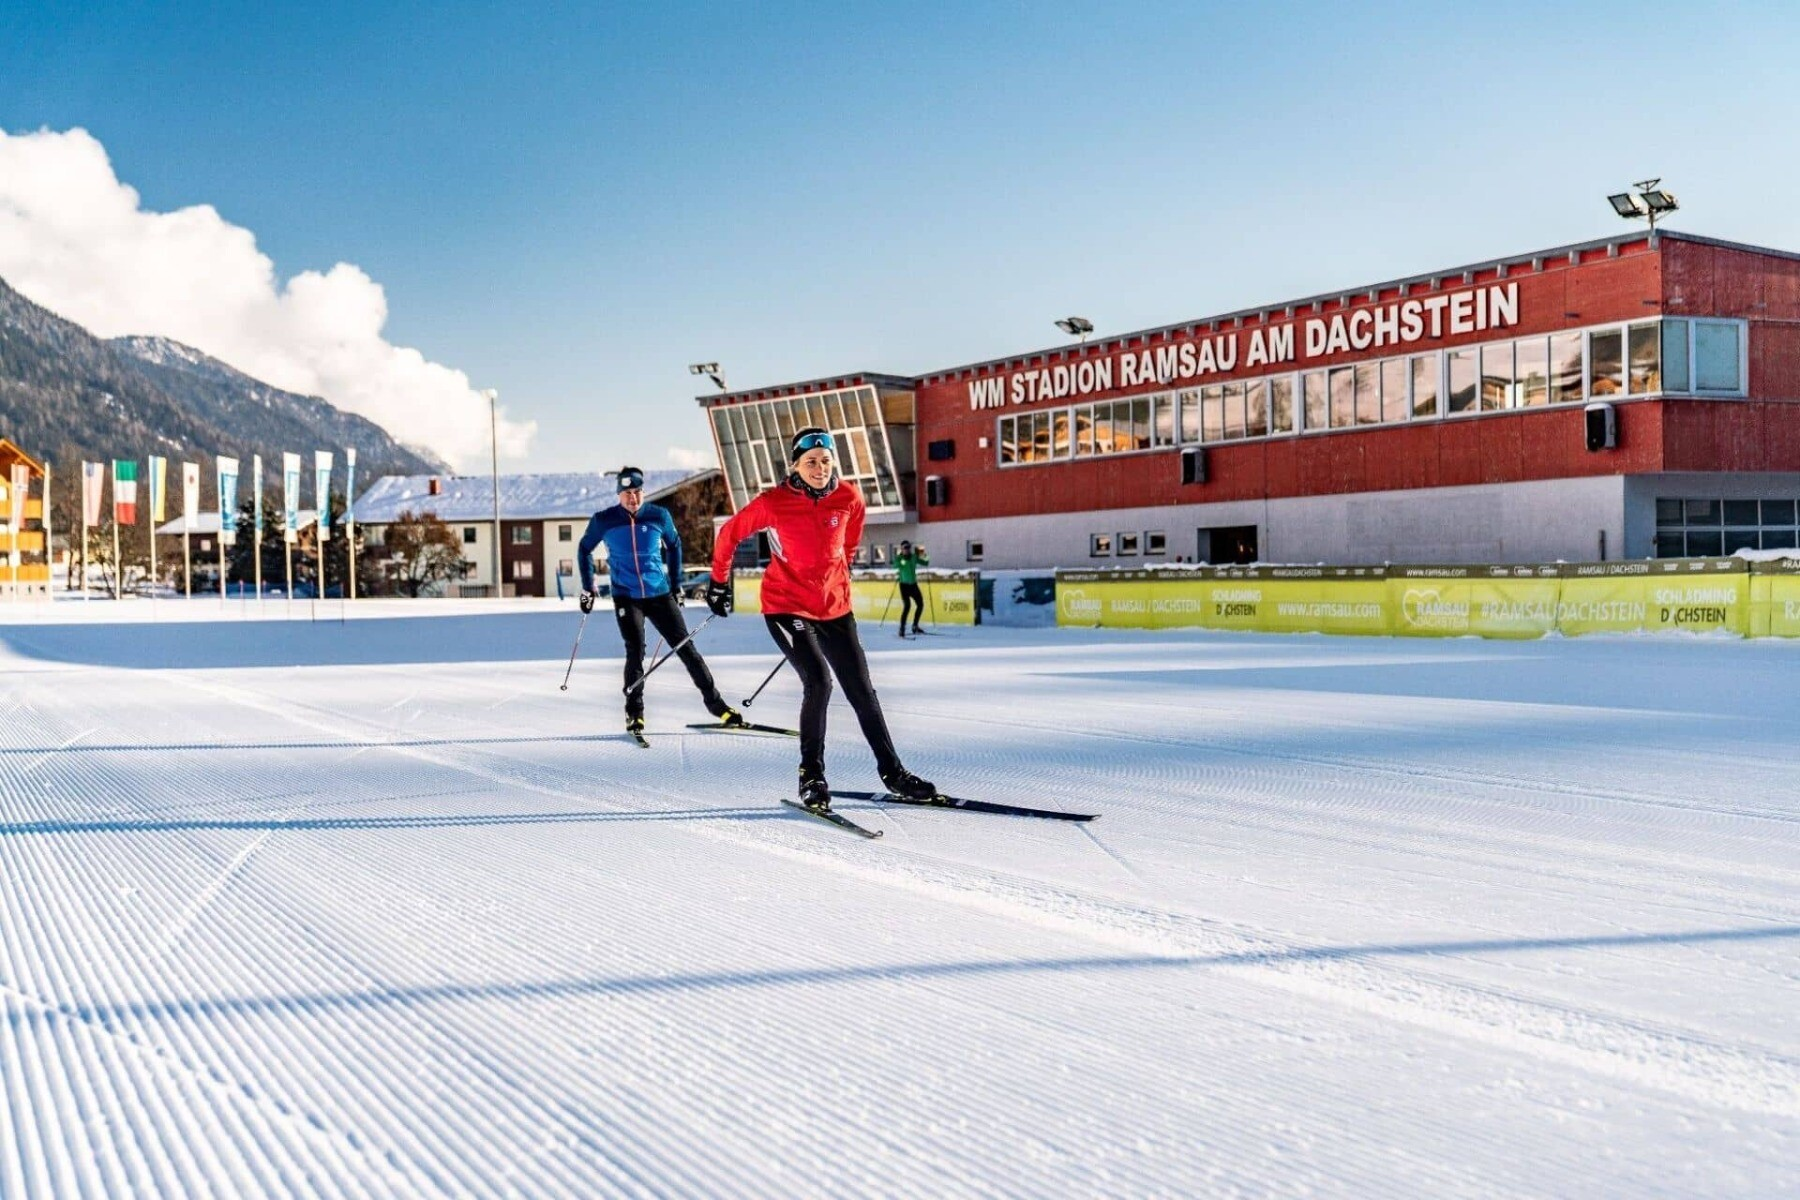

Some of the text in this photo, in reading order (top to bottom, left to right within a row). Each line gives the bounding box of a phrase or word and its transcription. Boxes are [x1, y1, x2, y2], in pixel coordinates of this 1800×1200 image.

[968, 282, 1519, 411] WM STADION RAMSAU AM DACHSTEIN
[1406, 568, 1468, 577] www.ramsau.com
[1577, 564, 1606, 575] RAMSAU
[1610, 563, 1650, 574] DACHSTEIN
[1655, 587, 1737, 605] SCHLADMING
[1152, 600, 1201, 613] DACHSTEIN
[1278, 602, 1381, 618] www.ramsau.com
[1416, 602, 1470, 616] RAMSAU
[1481, 600, 1646, 622] #RAMSAUDACHSTEIN
